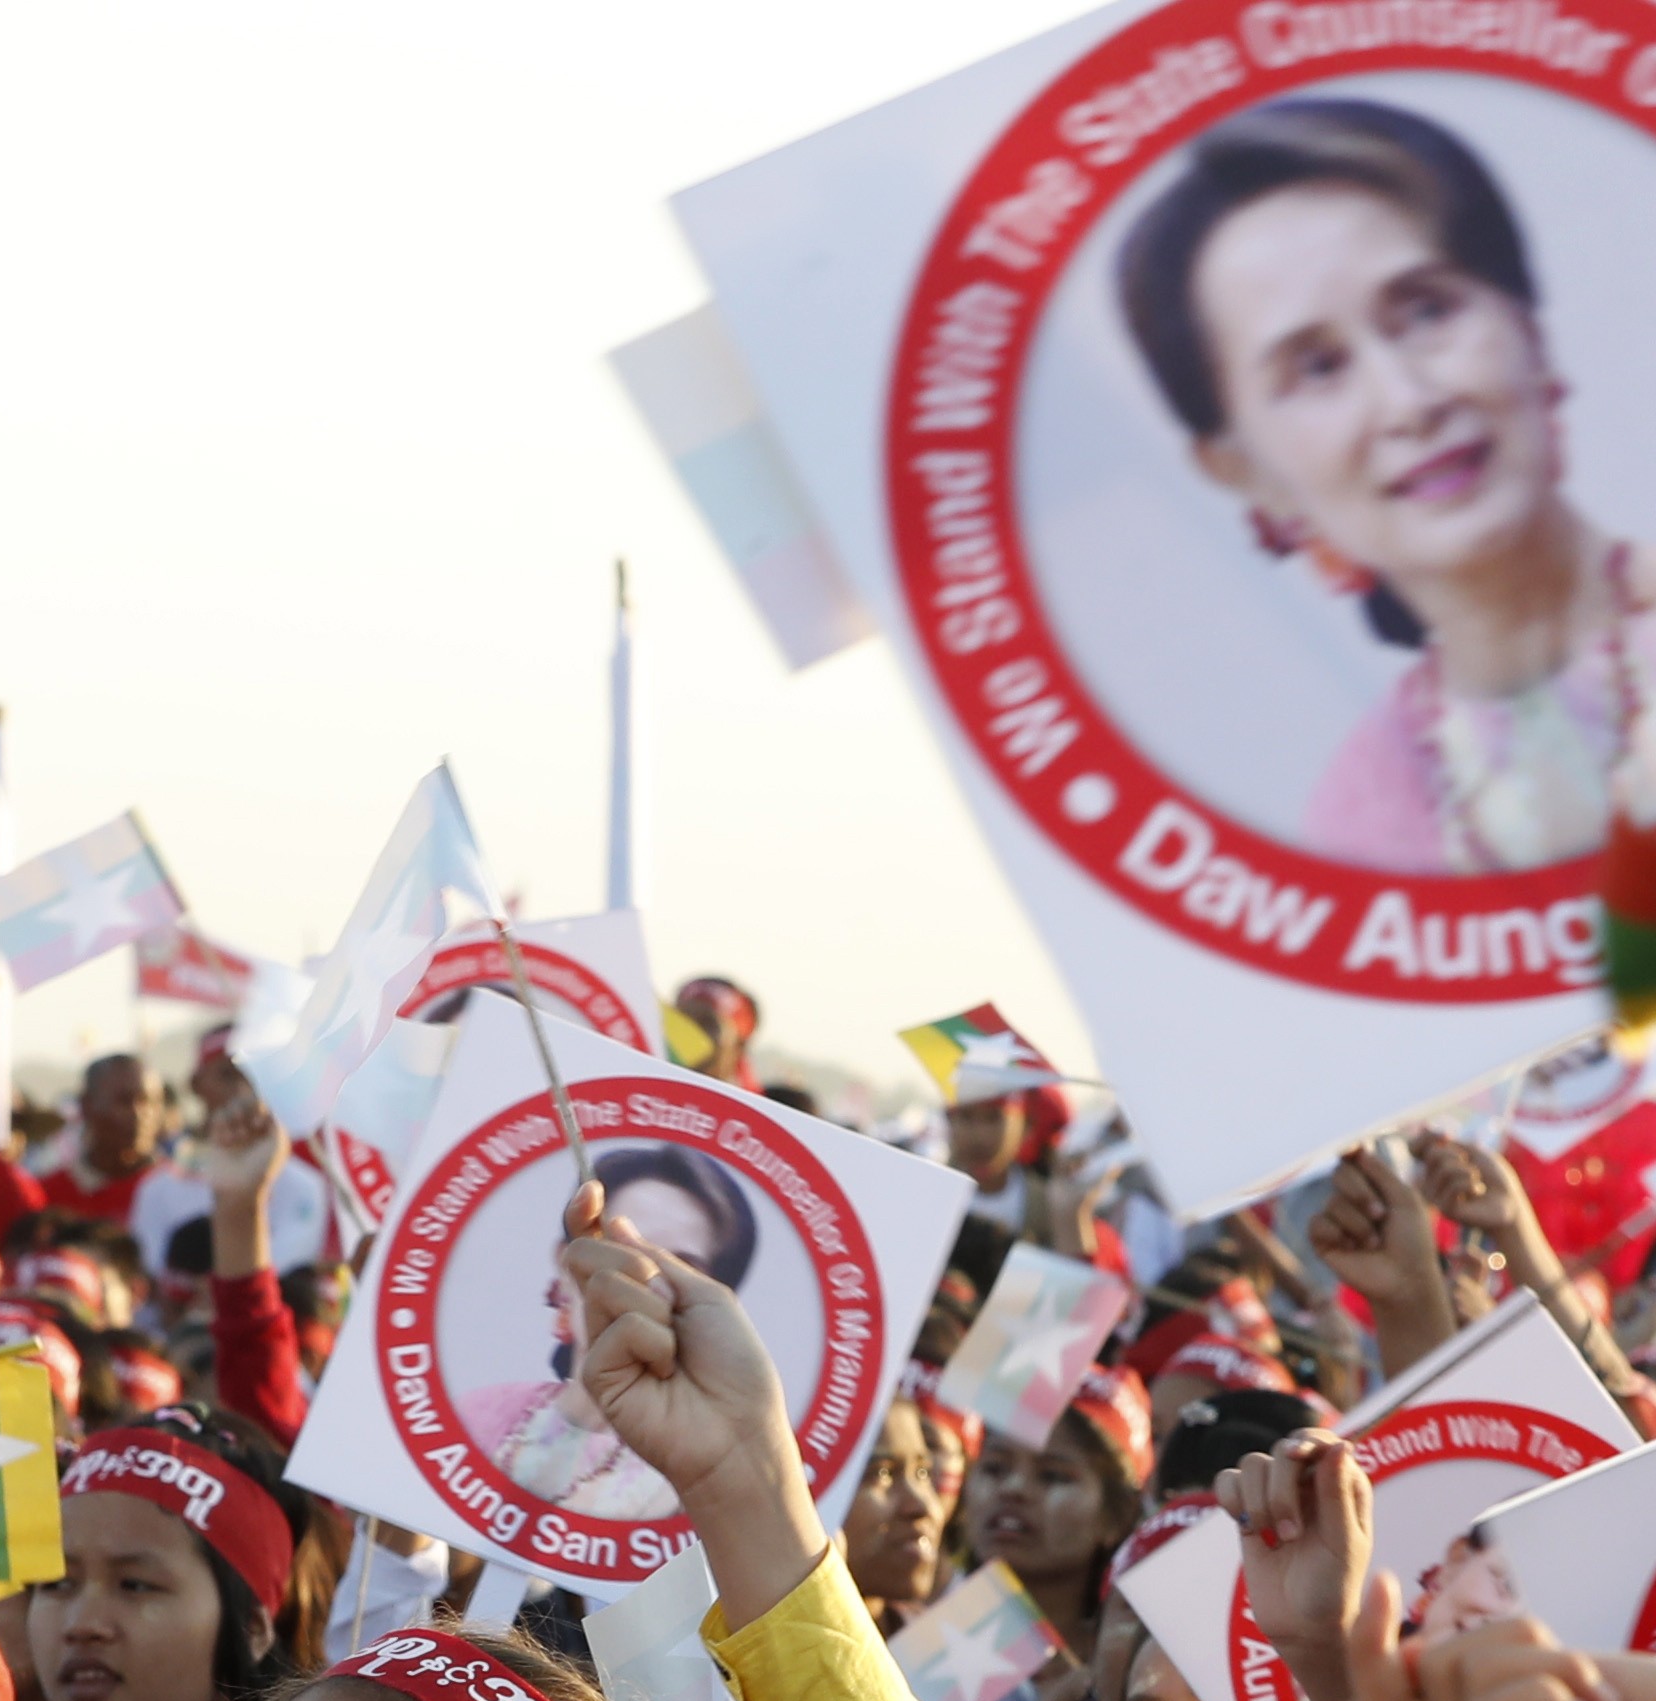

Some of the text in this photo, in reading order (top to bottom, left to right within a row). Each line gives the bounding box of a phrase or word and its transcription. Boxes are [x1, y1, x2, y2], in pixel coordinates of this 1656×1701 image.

[1117, 798, 1605, 984] Daw Aung
[626, 1094, 718, 1140] State
[412, 1154, 493, 1242] Stand
[716, 1117, 848, 1257] Counsellor
[390, 1248, 436, 1296] We
[828, 1262, 870, 1301] Of
[806, 1306, 872, 1460] Myanmar
[388, 1342, 702, 1569] Daw Aung San Su
[1353, 1416, 1443, 1475] Stand
